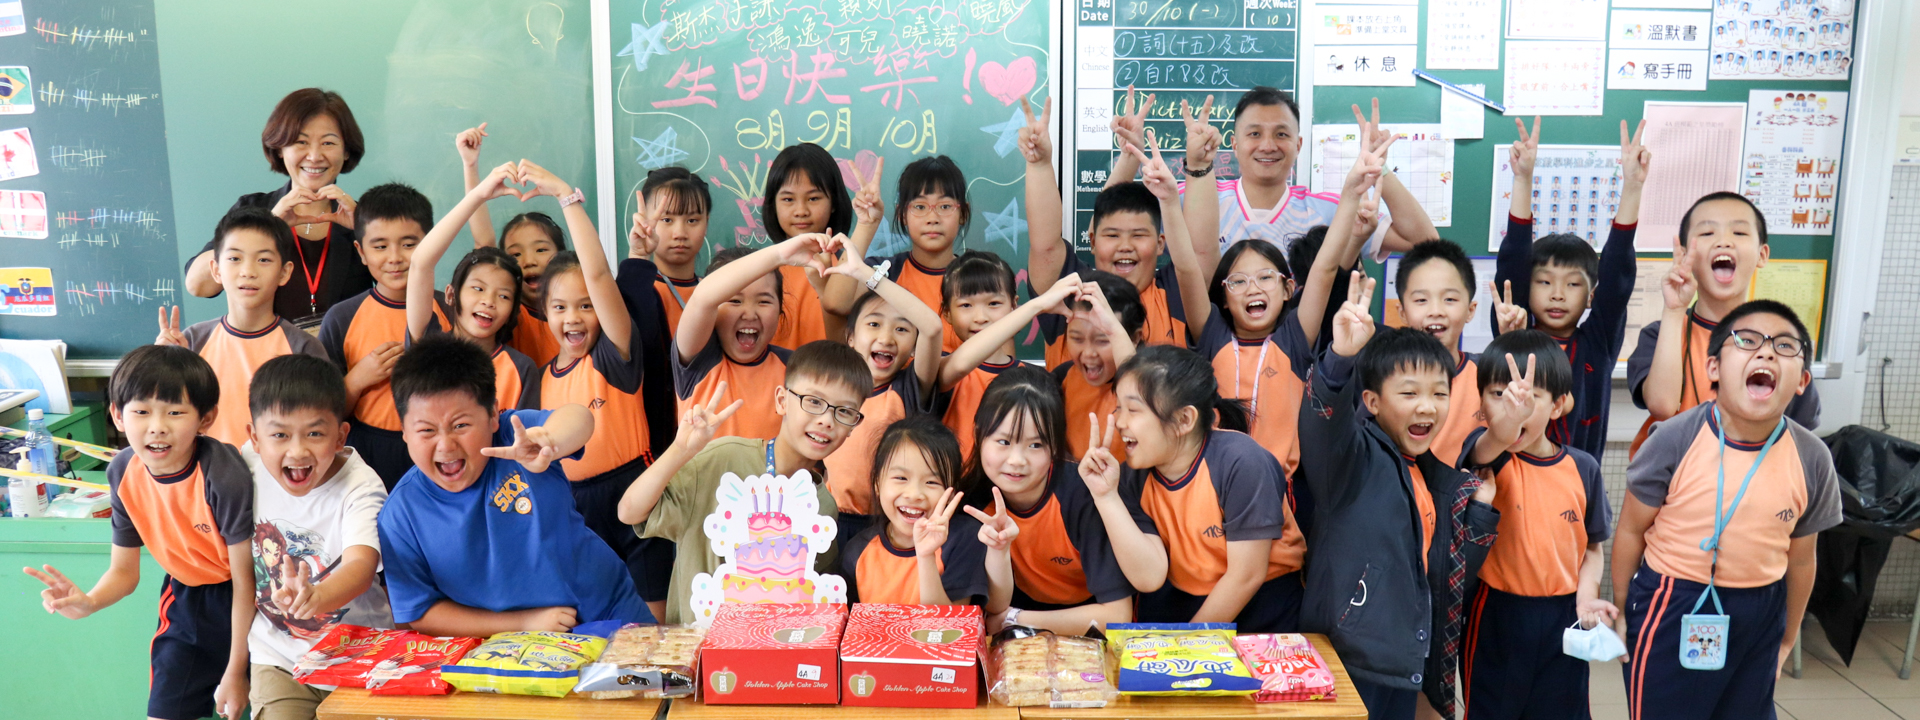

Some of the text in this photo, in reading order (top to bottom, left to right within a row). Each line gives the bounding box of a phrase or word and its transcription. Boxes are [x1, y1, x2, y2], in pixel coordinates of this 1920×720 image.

[1081, 10, 1109, 21] Date
[833, 26, 879, 56] 可兒
[902, 14, 958, 48] 曉諾
[1647, 24, 1698, 41] 溫默書
[1084, 45, 1108, 57] 中文
[1082, 63, 1109, 71] Chinese
[1354, 55, 1397, 72] 休息
[1643, 62, 1692, 79] 寫手冊
[1083, 107, 1107, 118] 英文
[879, 109, 937, 154] 10月
[1082, 124, 1108, 133] English
[1081, 170, 1107, 183] 數學
[494, 474, 529, 512] SKX
[771, 681, 795, 690] Apple
[813, 681, 828, 689] Shop
[910, 685, 934, 694] Apple
